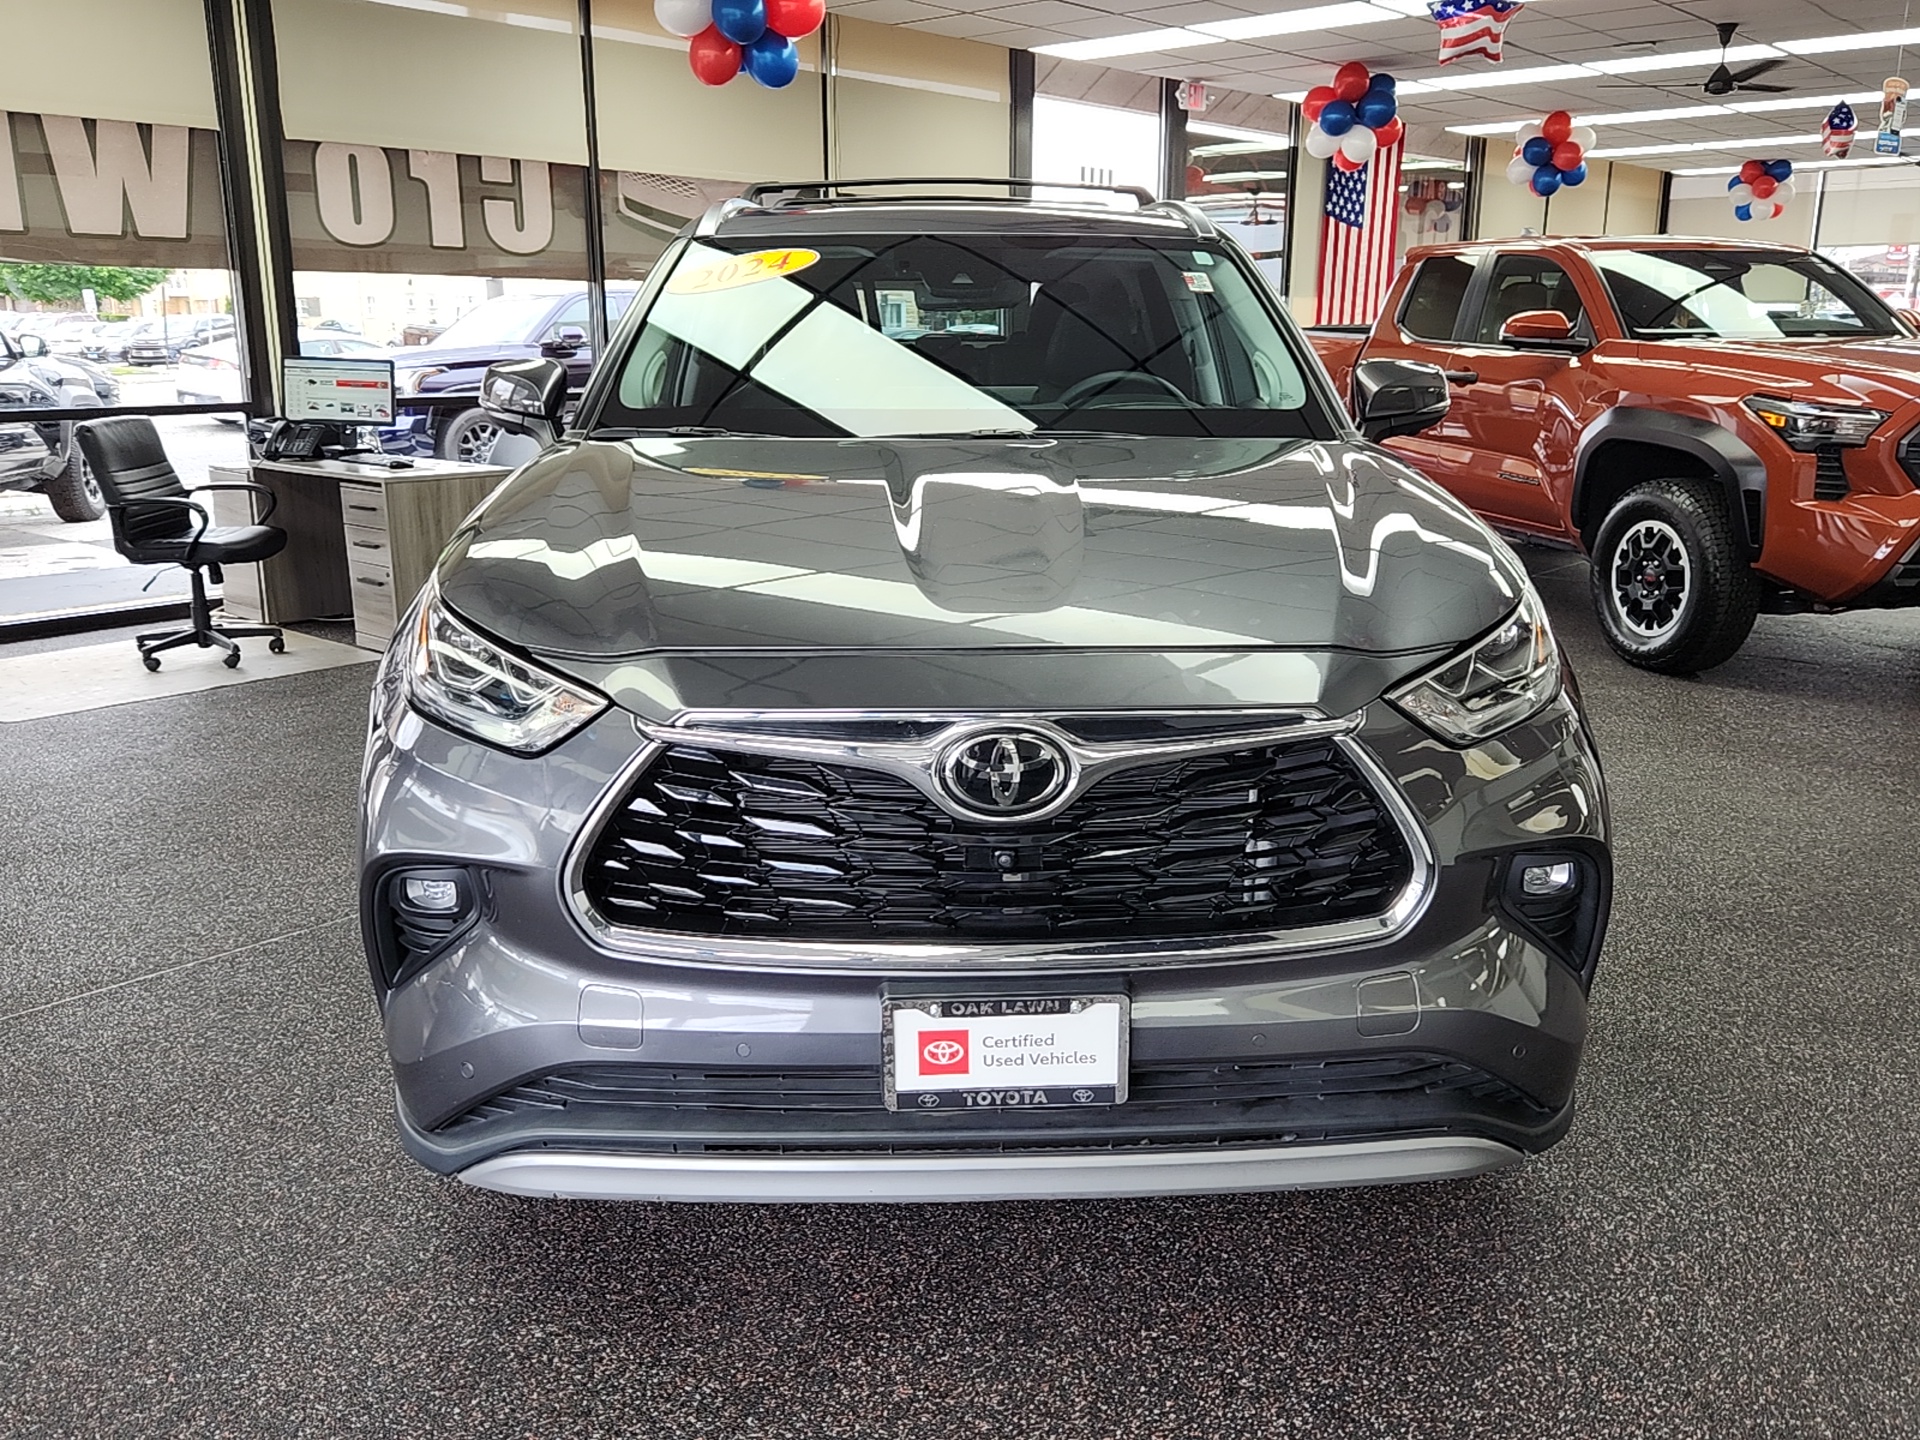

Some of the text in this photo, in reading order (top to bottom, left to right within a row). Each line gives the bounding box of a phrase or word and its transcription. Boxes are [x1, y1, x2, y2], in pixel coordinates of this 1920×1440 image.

[693, 251, 793, 289] 2024
[950, 1000, 1060, 1016] OAK LAWN
[982, 1033, 1056, 1049] Certified
[983, 1050, 1098, 1067] Used Vehicles
[962, 1090, 1048, 1106] TOYOTA
